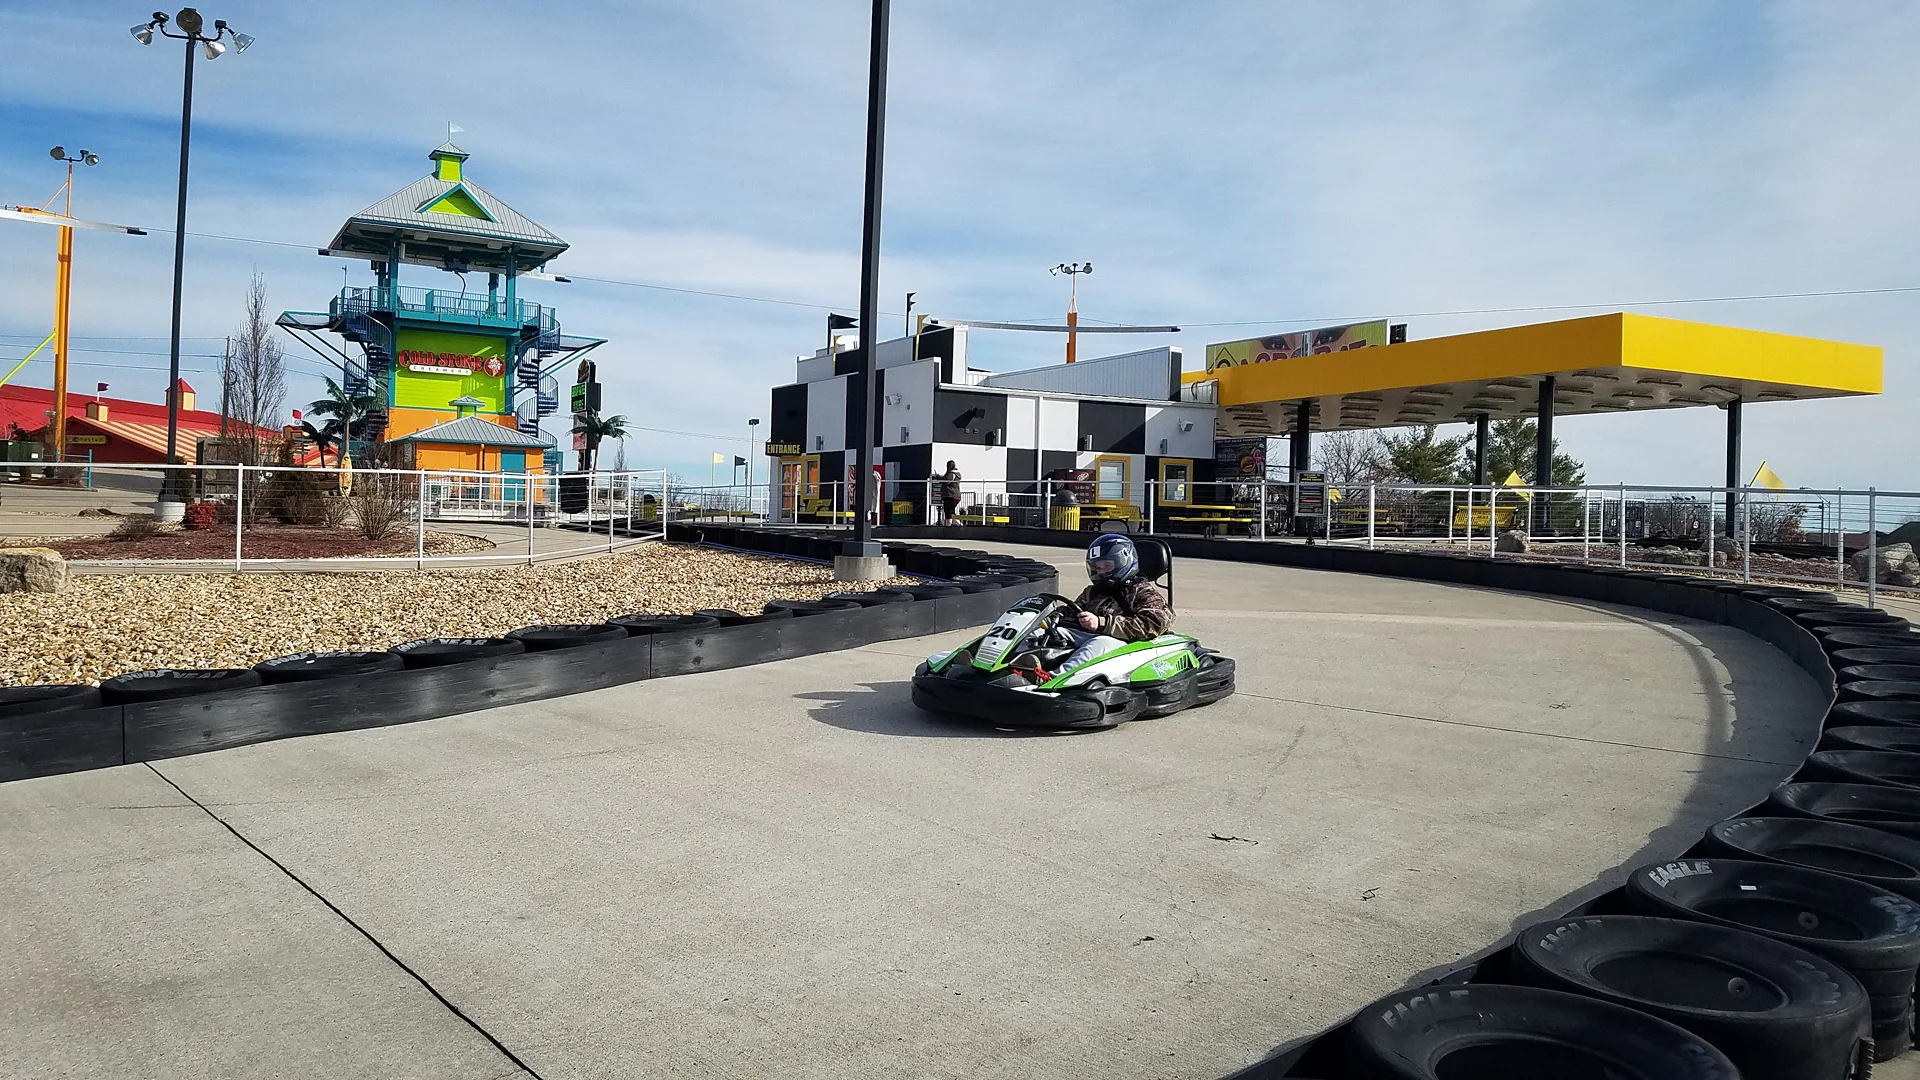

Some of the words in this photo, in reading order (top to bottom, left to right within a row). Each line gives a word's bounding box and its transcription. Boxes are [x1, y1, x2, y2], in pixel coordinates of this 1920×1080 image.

[399, 349, 437, 367] COLD
[438, 352, 484, 373] STONE
[413, 365, 469, 374] CREAMERY
[767, 444, 801, 454] ENTRANCE
[987, 626, 1018, 640] 20
[1648, 860, 1714, 888] EAGLE
